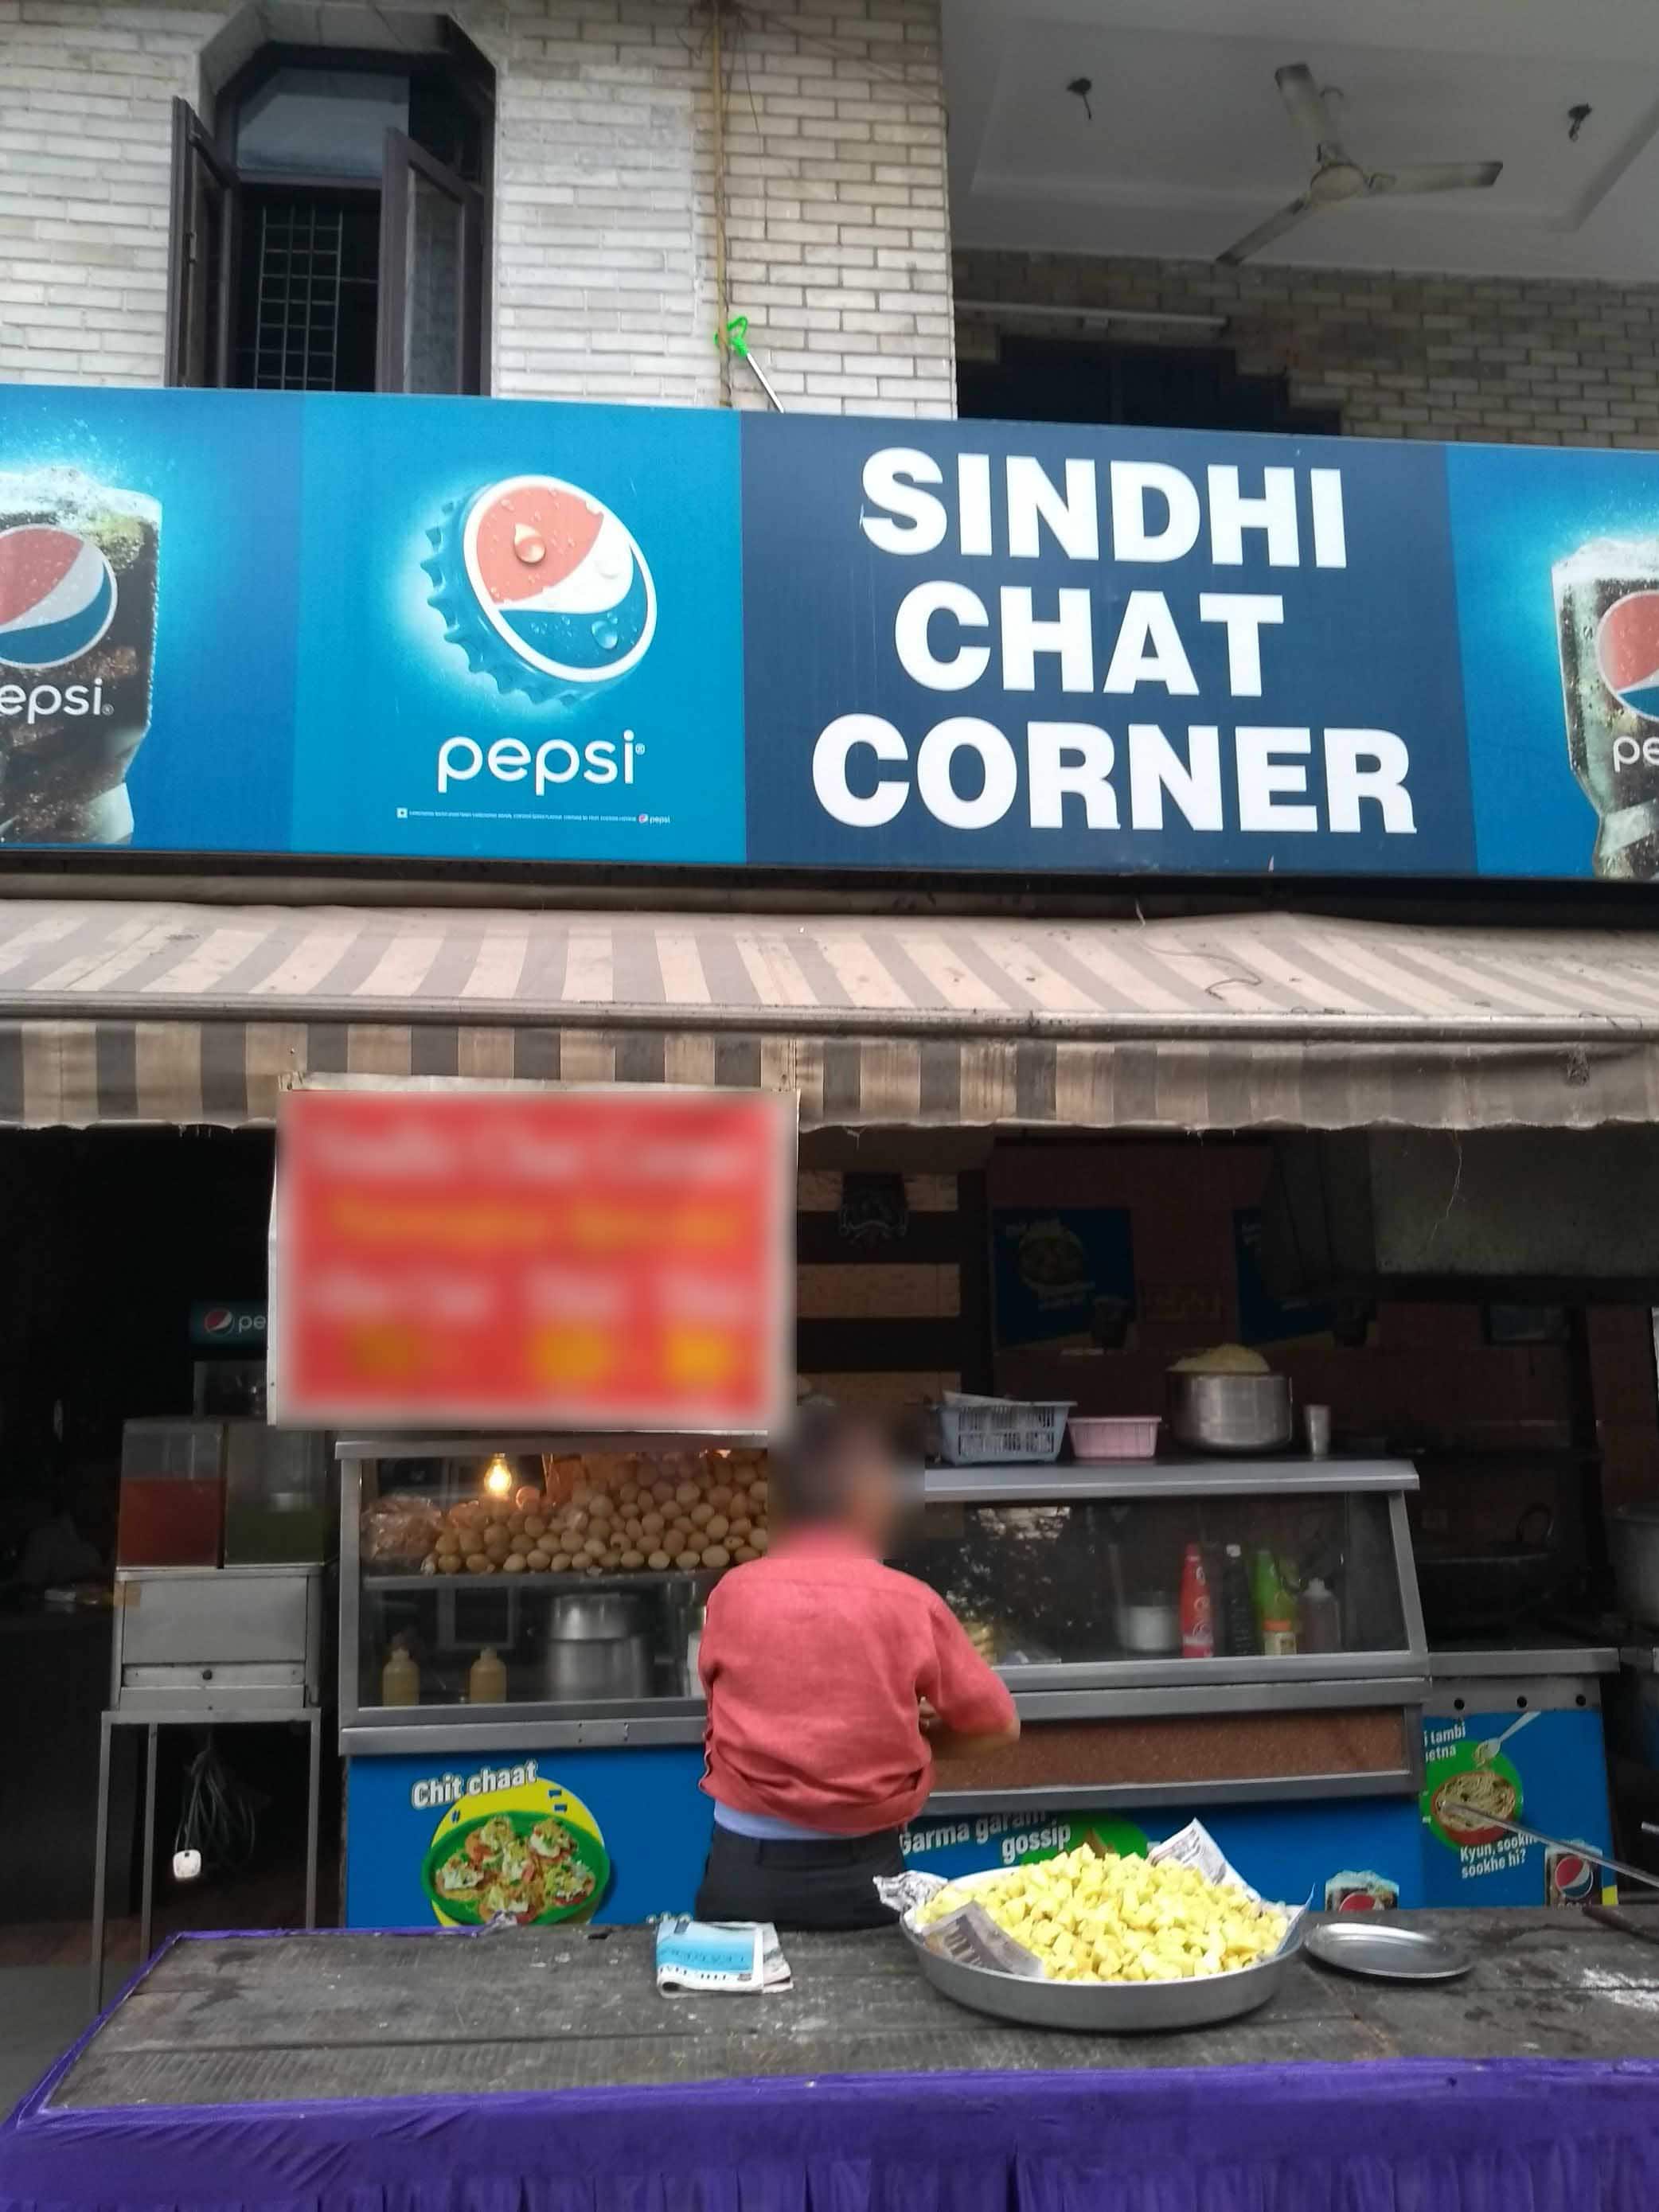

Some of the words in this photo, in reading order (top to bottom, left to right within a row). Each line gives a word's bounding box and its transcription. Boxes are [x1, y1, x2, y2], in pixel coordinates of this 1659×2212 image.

[861, 447, 1347, 568] SINDHI
[894, 580, 1285, 697] CHAT
[438, 729, 634, 796] pepsi
[812, 713, 1417, 833] CORNER
[412, 1773, 463, 1808] Chit
[468, 1759, 537, 1796] chaat
[1001, 1820, 1072, 1864] gossip
[1462, 1855, 1505, 1878] sookhe
[1509, 1847, 1526, 1866] hi?
